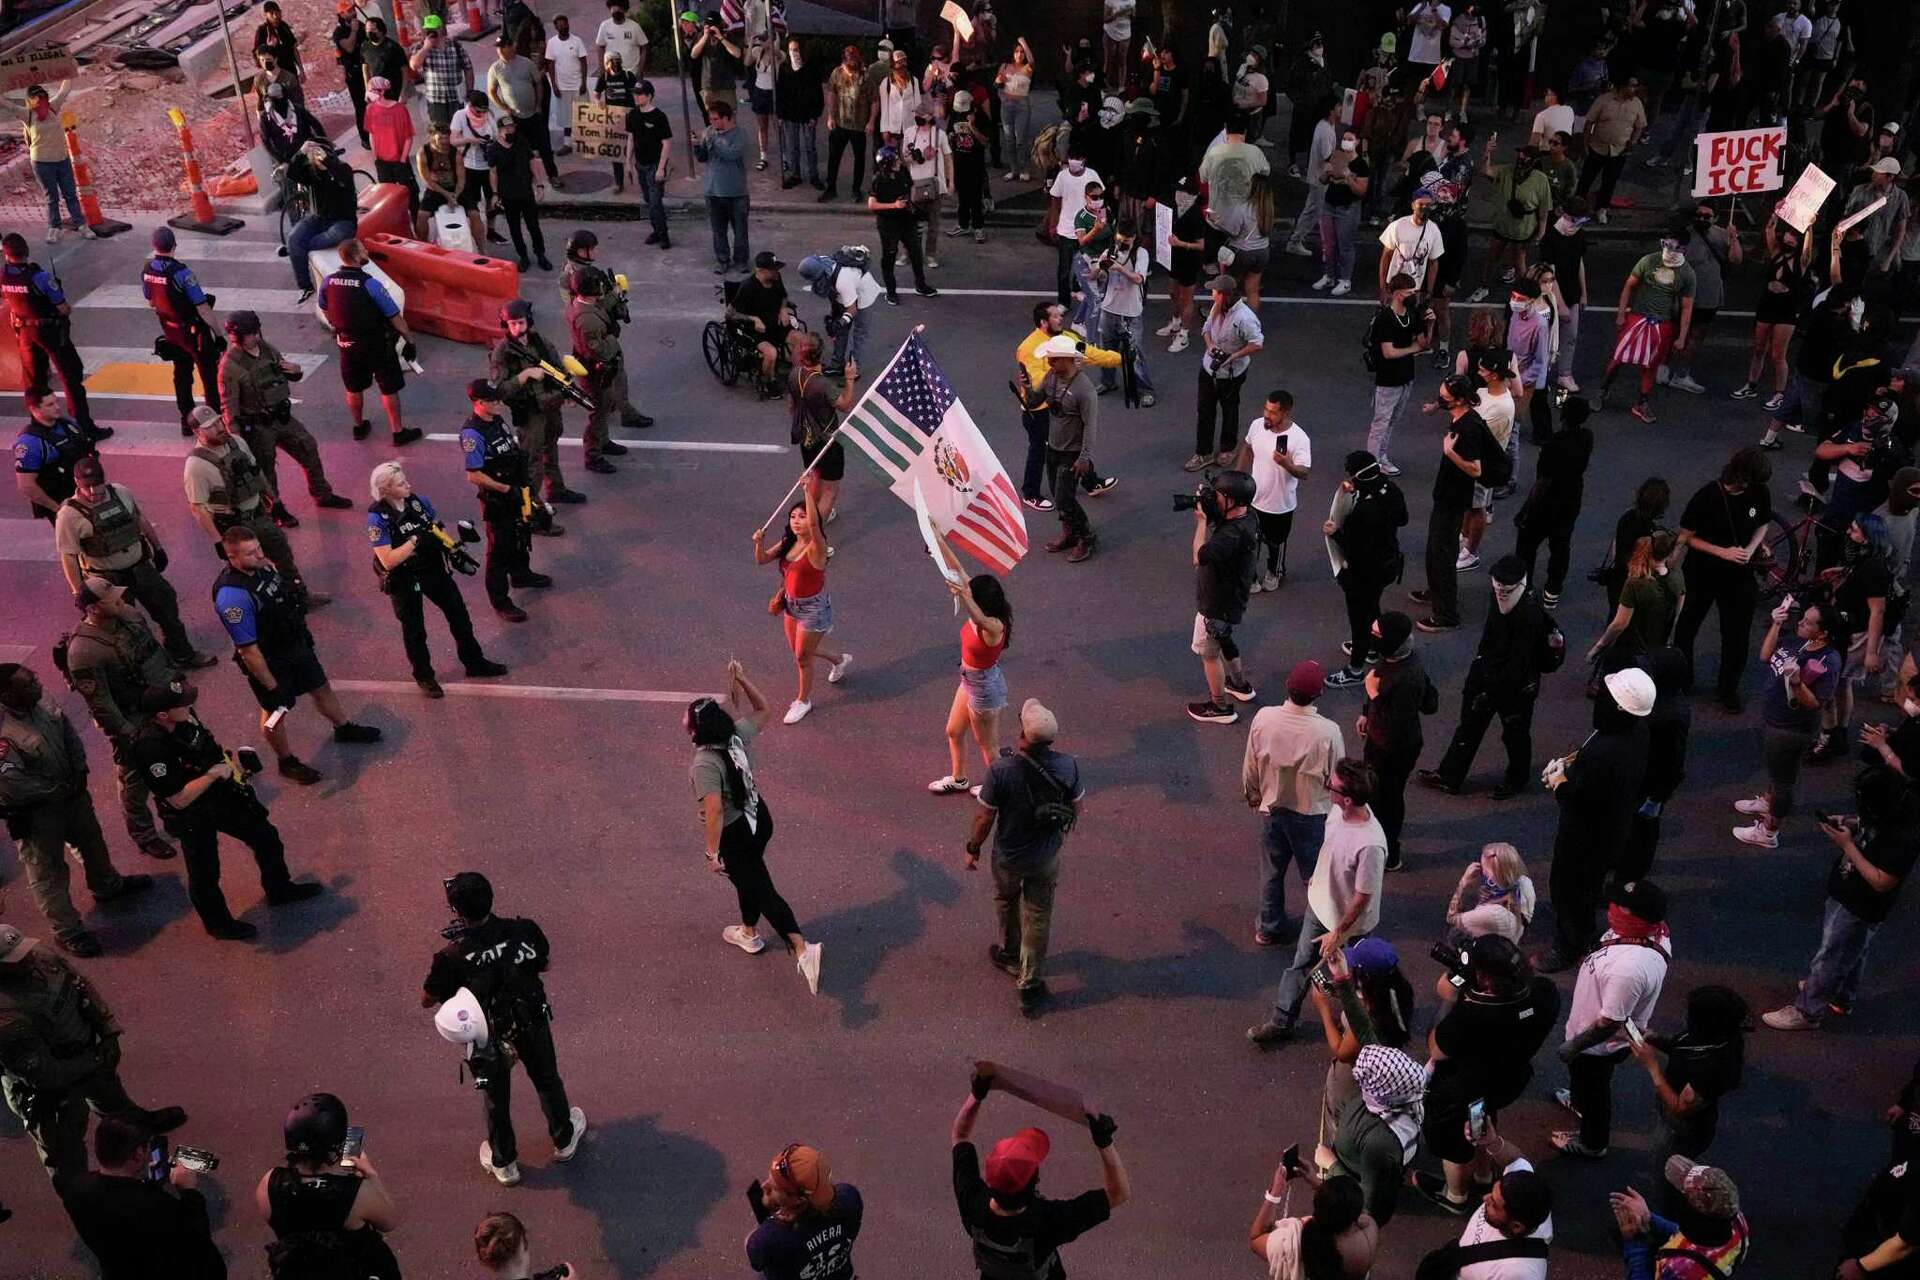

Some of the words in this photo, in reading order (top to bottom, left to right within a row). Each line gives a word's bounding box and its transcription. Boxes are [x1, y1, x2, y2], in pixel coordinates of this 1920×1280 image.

[578, 125, 601, 137] Tom
[604, 127, 629, 140] Hom
[575, 140, 595, 155] The
[1711, 133, 1781, 167] FUCK
[1708, 163, 1767, 195] ICE
[1, 284, 29, 294] POLICE
[328, 277, 361, 288] POLICE
[806, 1223, 842, 1252] RIVERA
